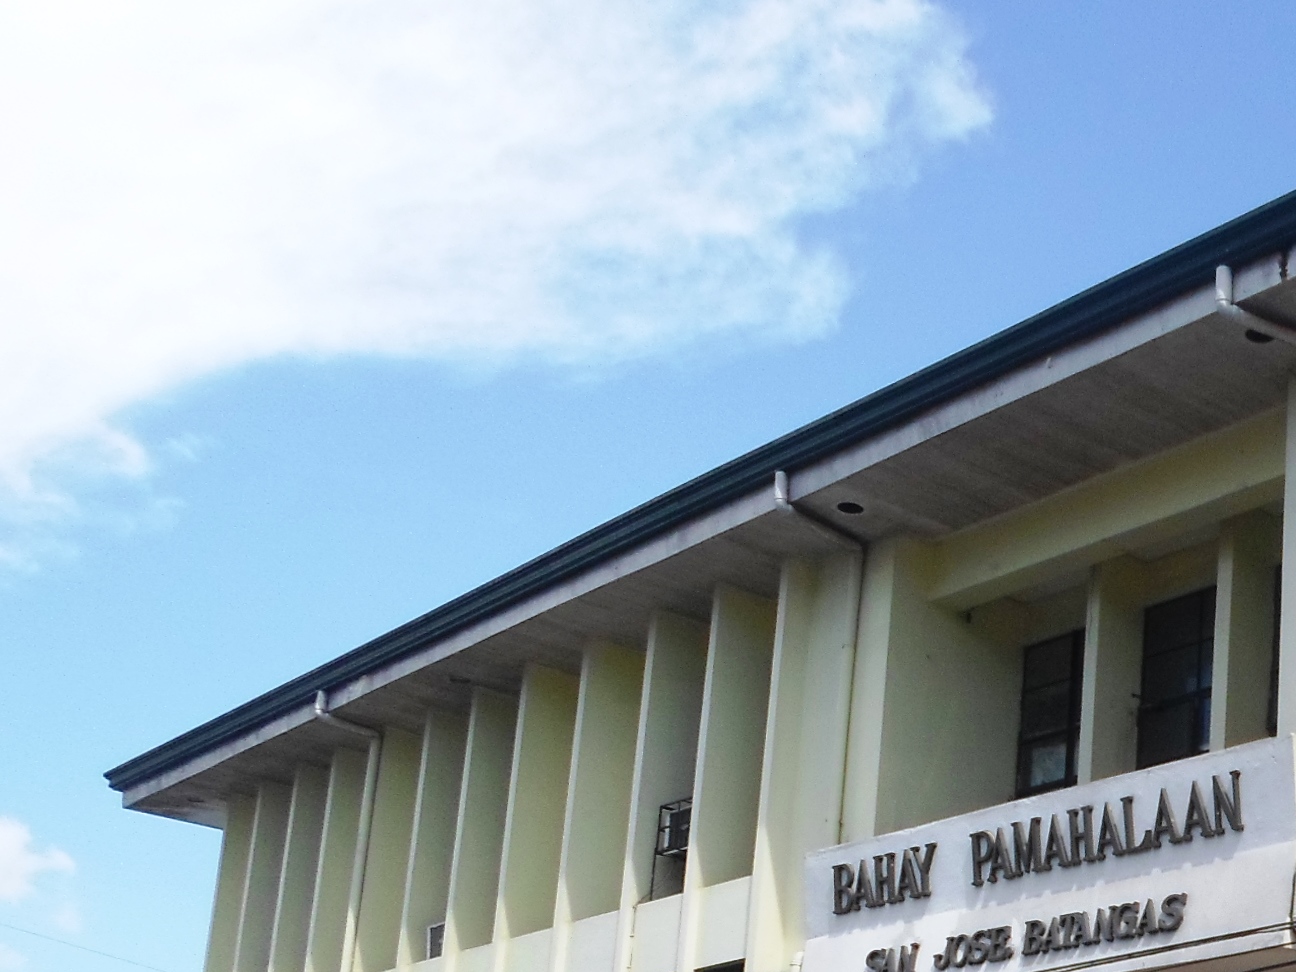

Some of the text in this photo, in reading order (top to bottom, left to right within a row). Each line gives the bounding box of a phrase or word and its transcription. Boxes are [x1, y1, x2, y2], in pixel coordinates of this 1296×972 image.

[832, 769, 1244, 914] BAHAY PAMAHALAAN
[933, 926, 1014, 970] JOSE
[1021, 892, 1188, 956] BATANGAS
